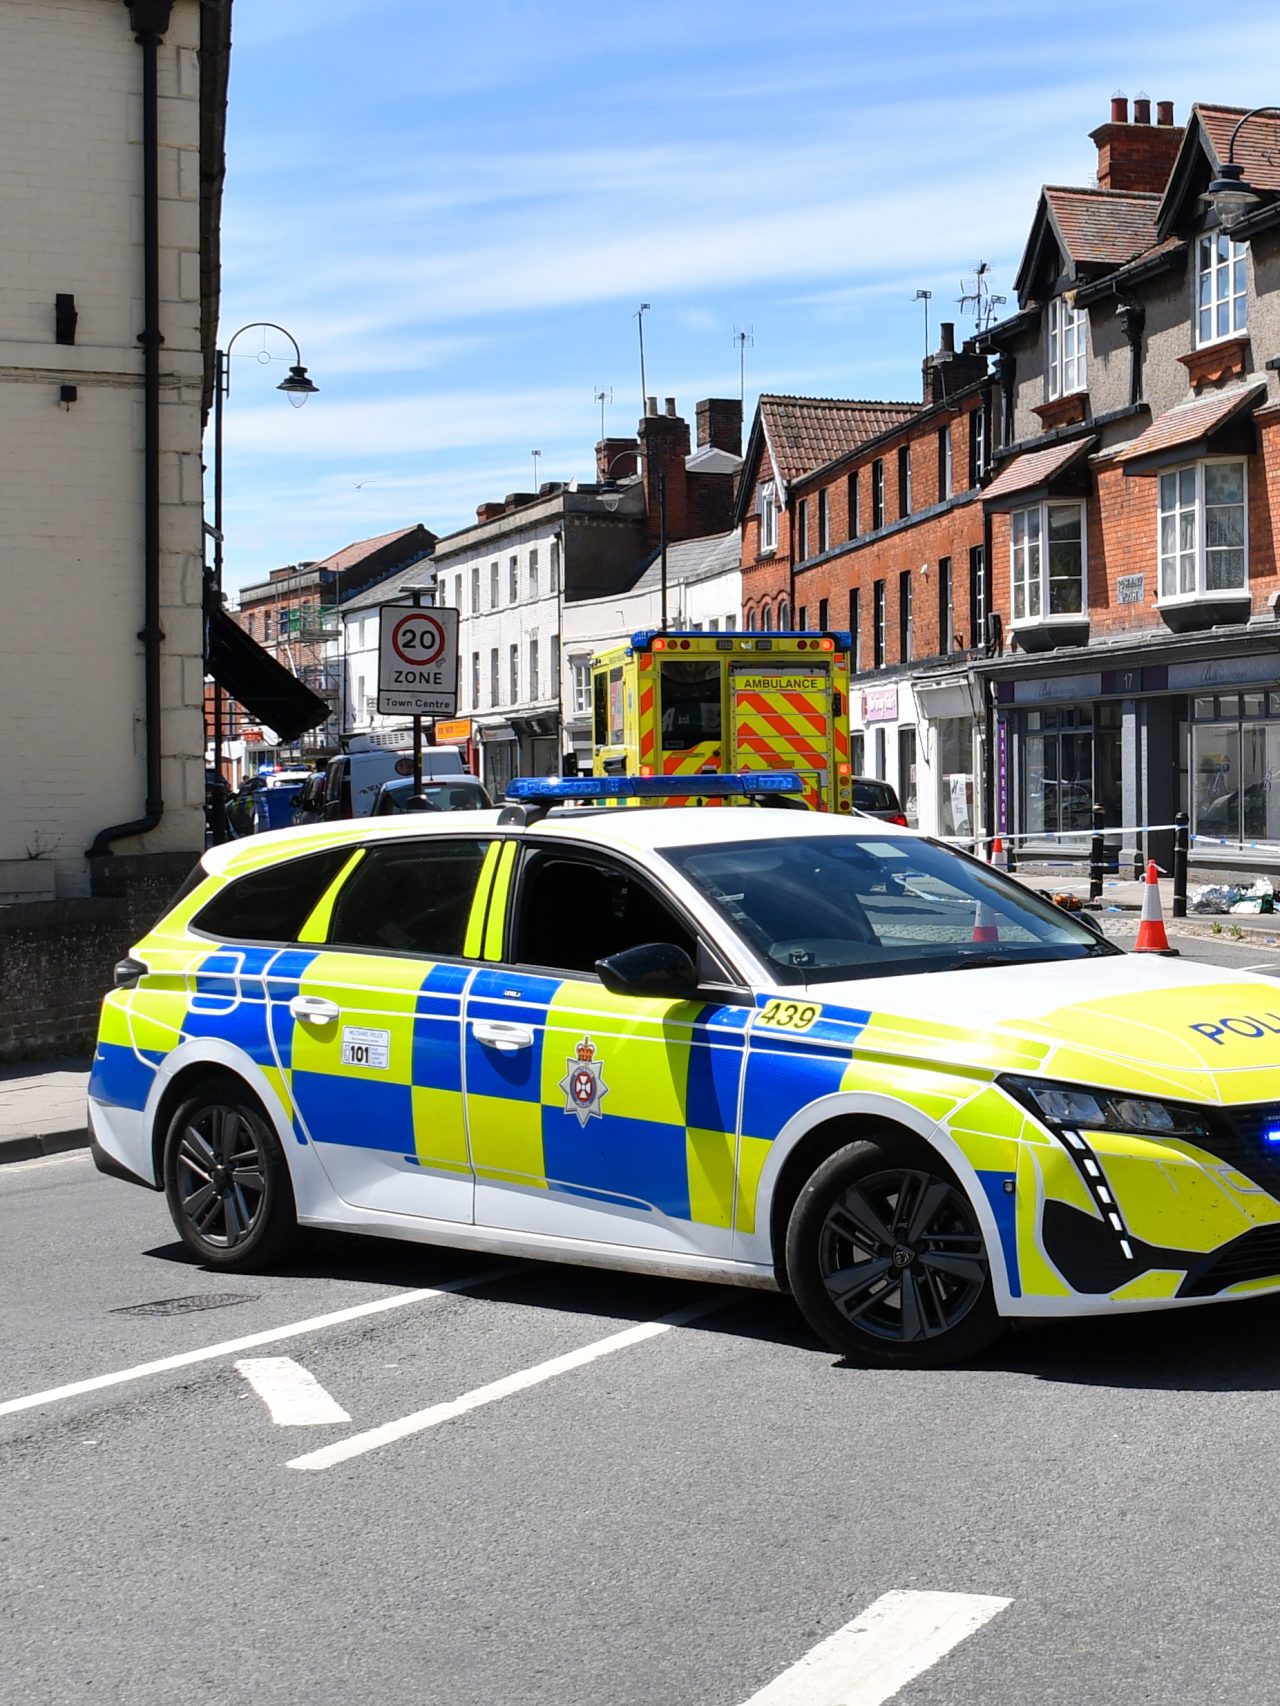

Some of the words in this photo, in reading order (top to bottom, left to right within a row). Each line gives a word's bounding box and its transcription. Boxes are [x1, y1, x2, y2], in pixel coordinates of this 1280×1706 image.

[401, 629, 436, 649] 20
[394, 671, 443, 685] ZONE
[744, 679, 818, 689] AMBULANCE
[1124, 673, 1133, 690] 17
[385, 698, 413, 707] Town
[415, 699, 450, 709] Centre
[760, 1002, 816, 1029] 439
[351, 1045, 369, 1064] 101
